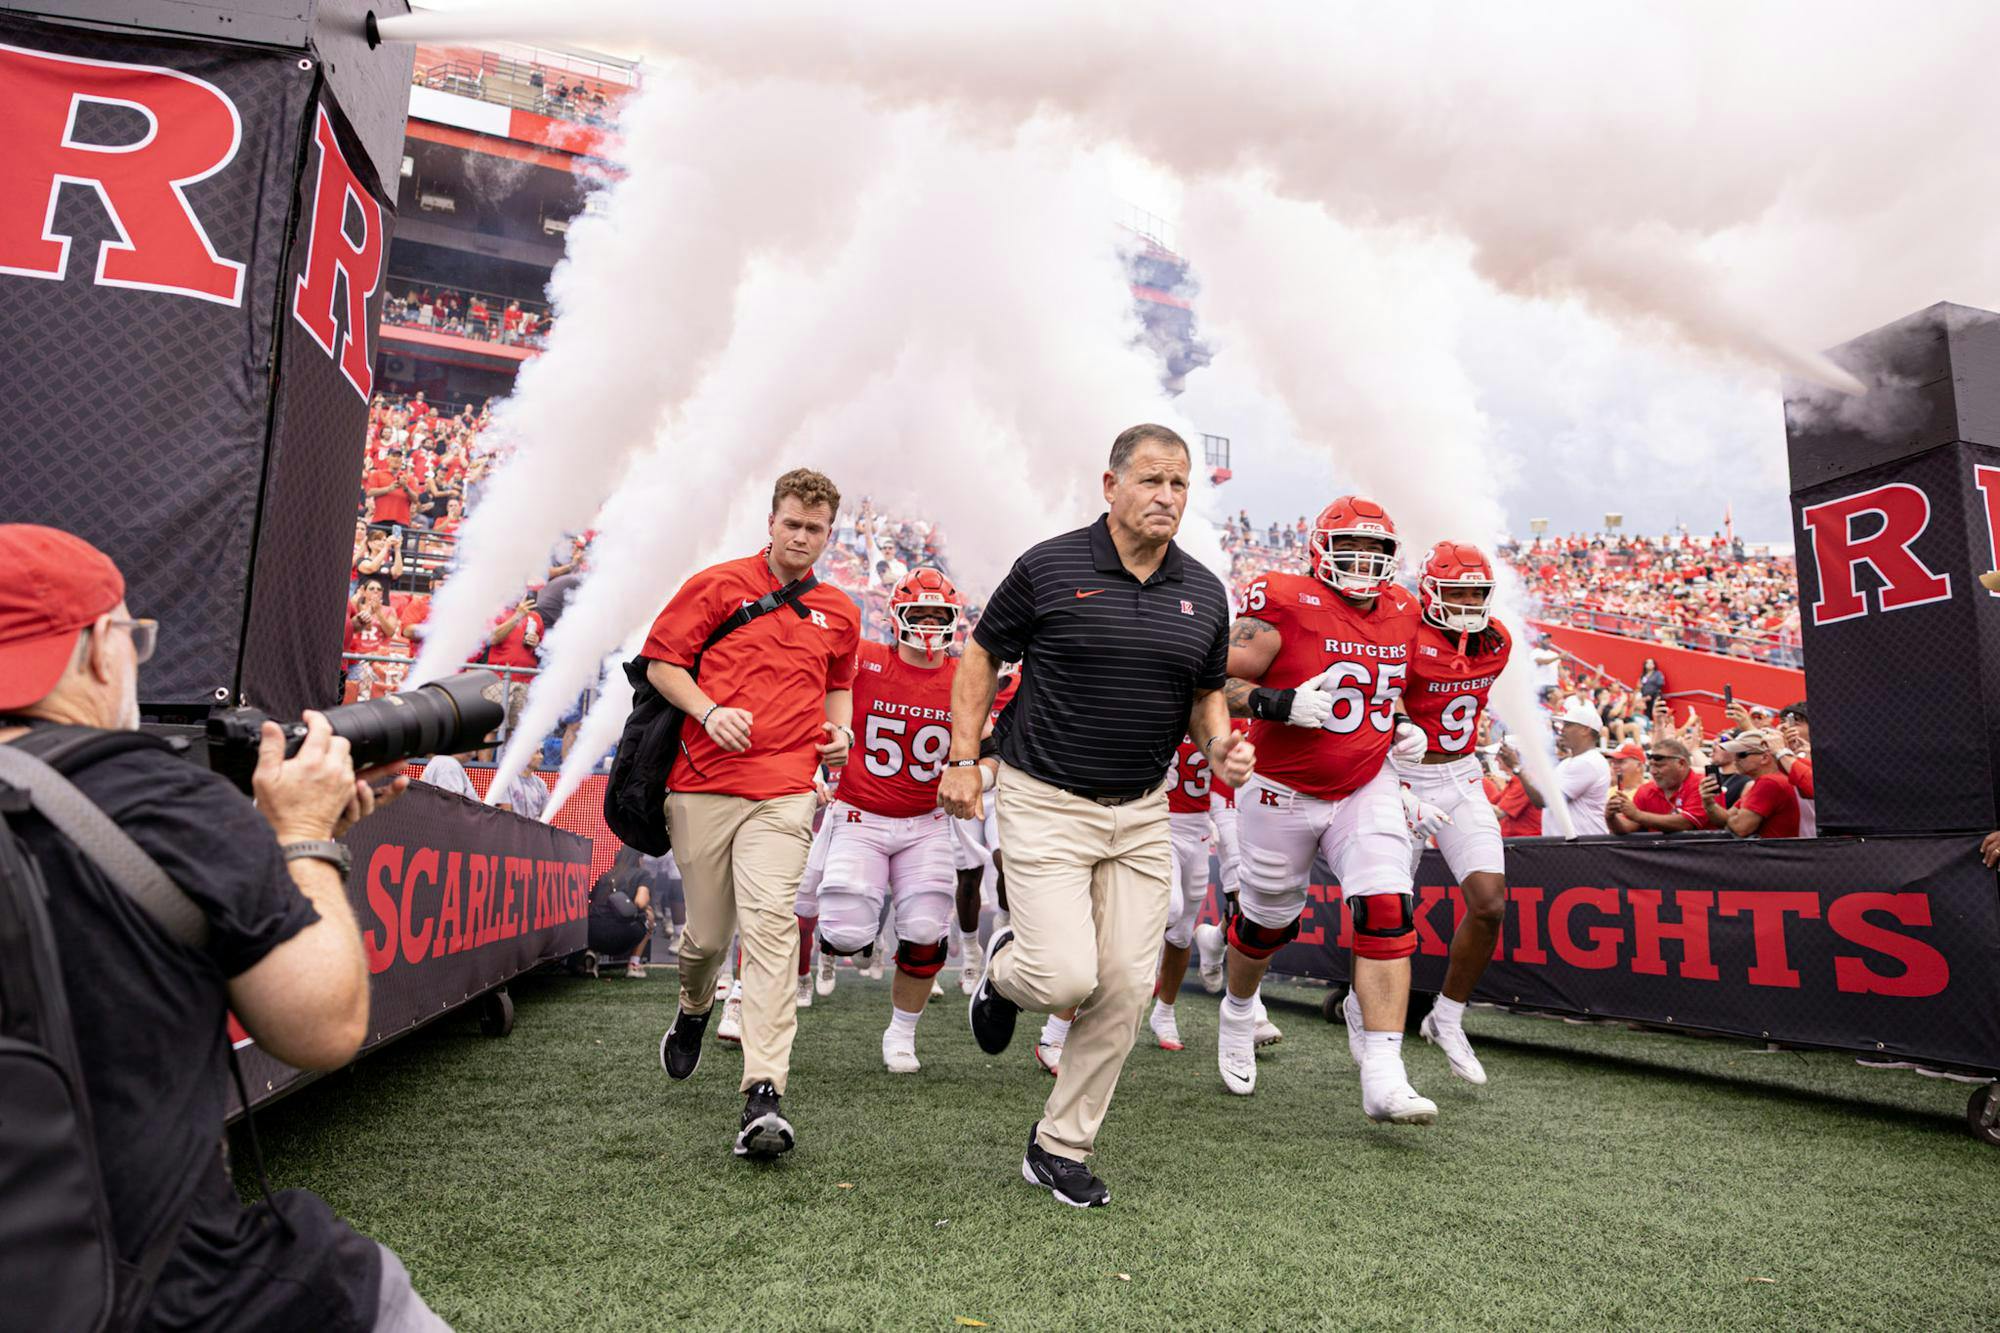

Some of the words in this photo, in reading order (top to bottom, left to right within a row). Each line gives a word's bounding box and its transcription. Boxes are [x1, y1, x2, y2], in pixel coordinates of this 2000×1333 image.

[0, 43, 246, 308] R
[293, 101, 384, 405] R
[1802, 482, 1952, 627] R
[811, 609, 829, 630] R
[1323, 638, 1407, 660] RUTGERS
[1320, 659, 1408, 735] 65
[1428, 675, 1496, 693] RUTGERS
[864, 713, 952, 783] 59
[1438, 694, 1479, 752] 9
[847, 810, 862, 823] R
[1260, 787, 1280, 807] R
[363, 843, 533, 975] SCARLET
